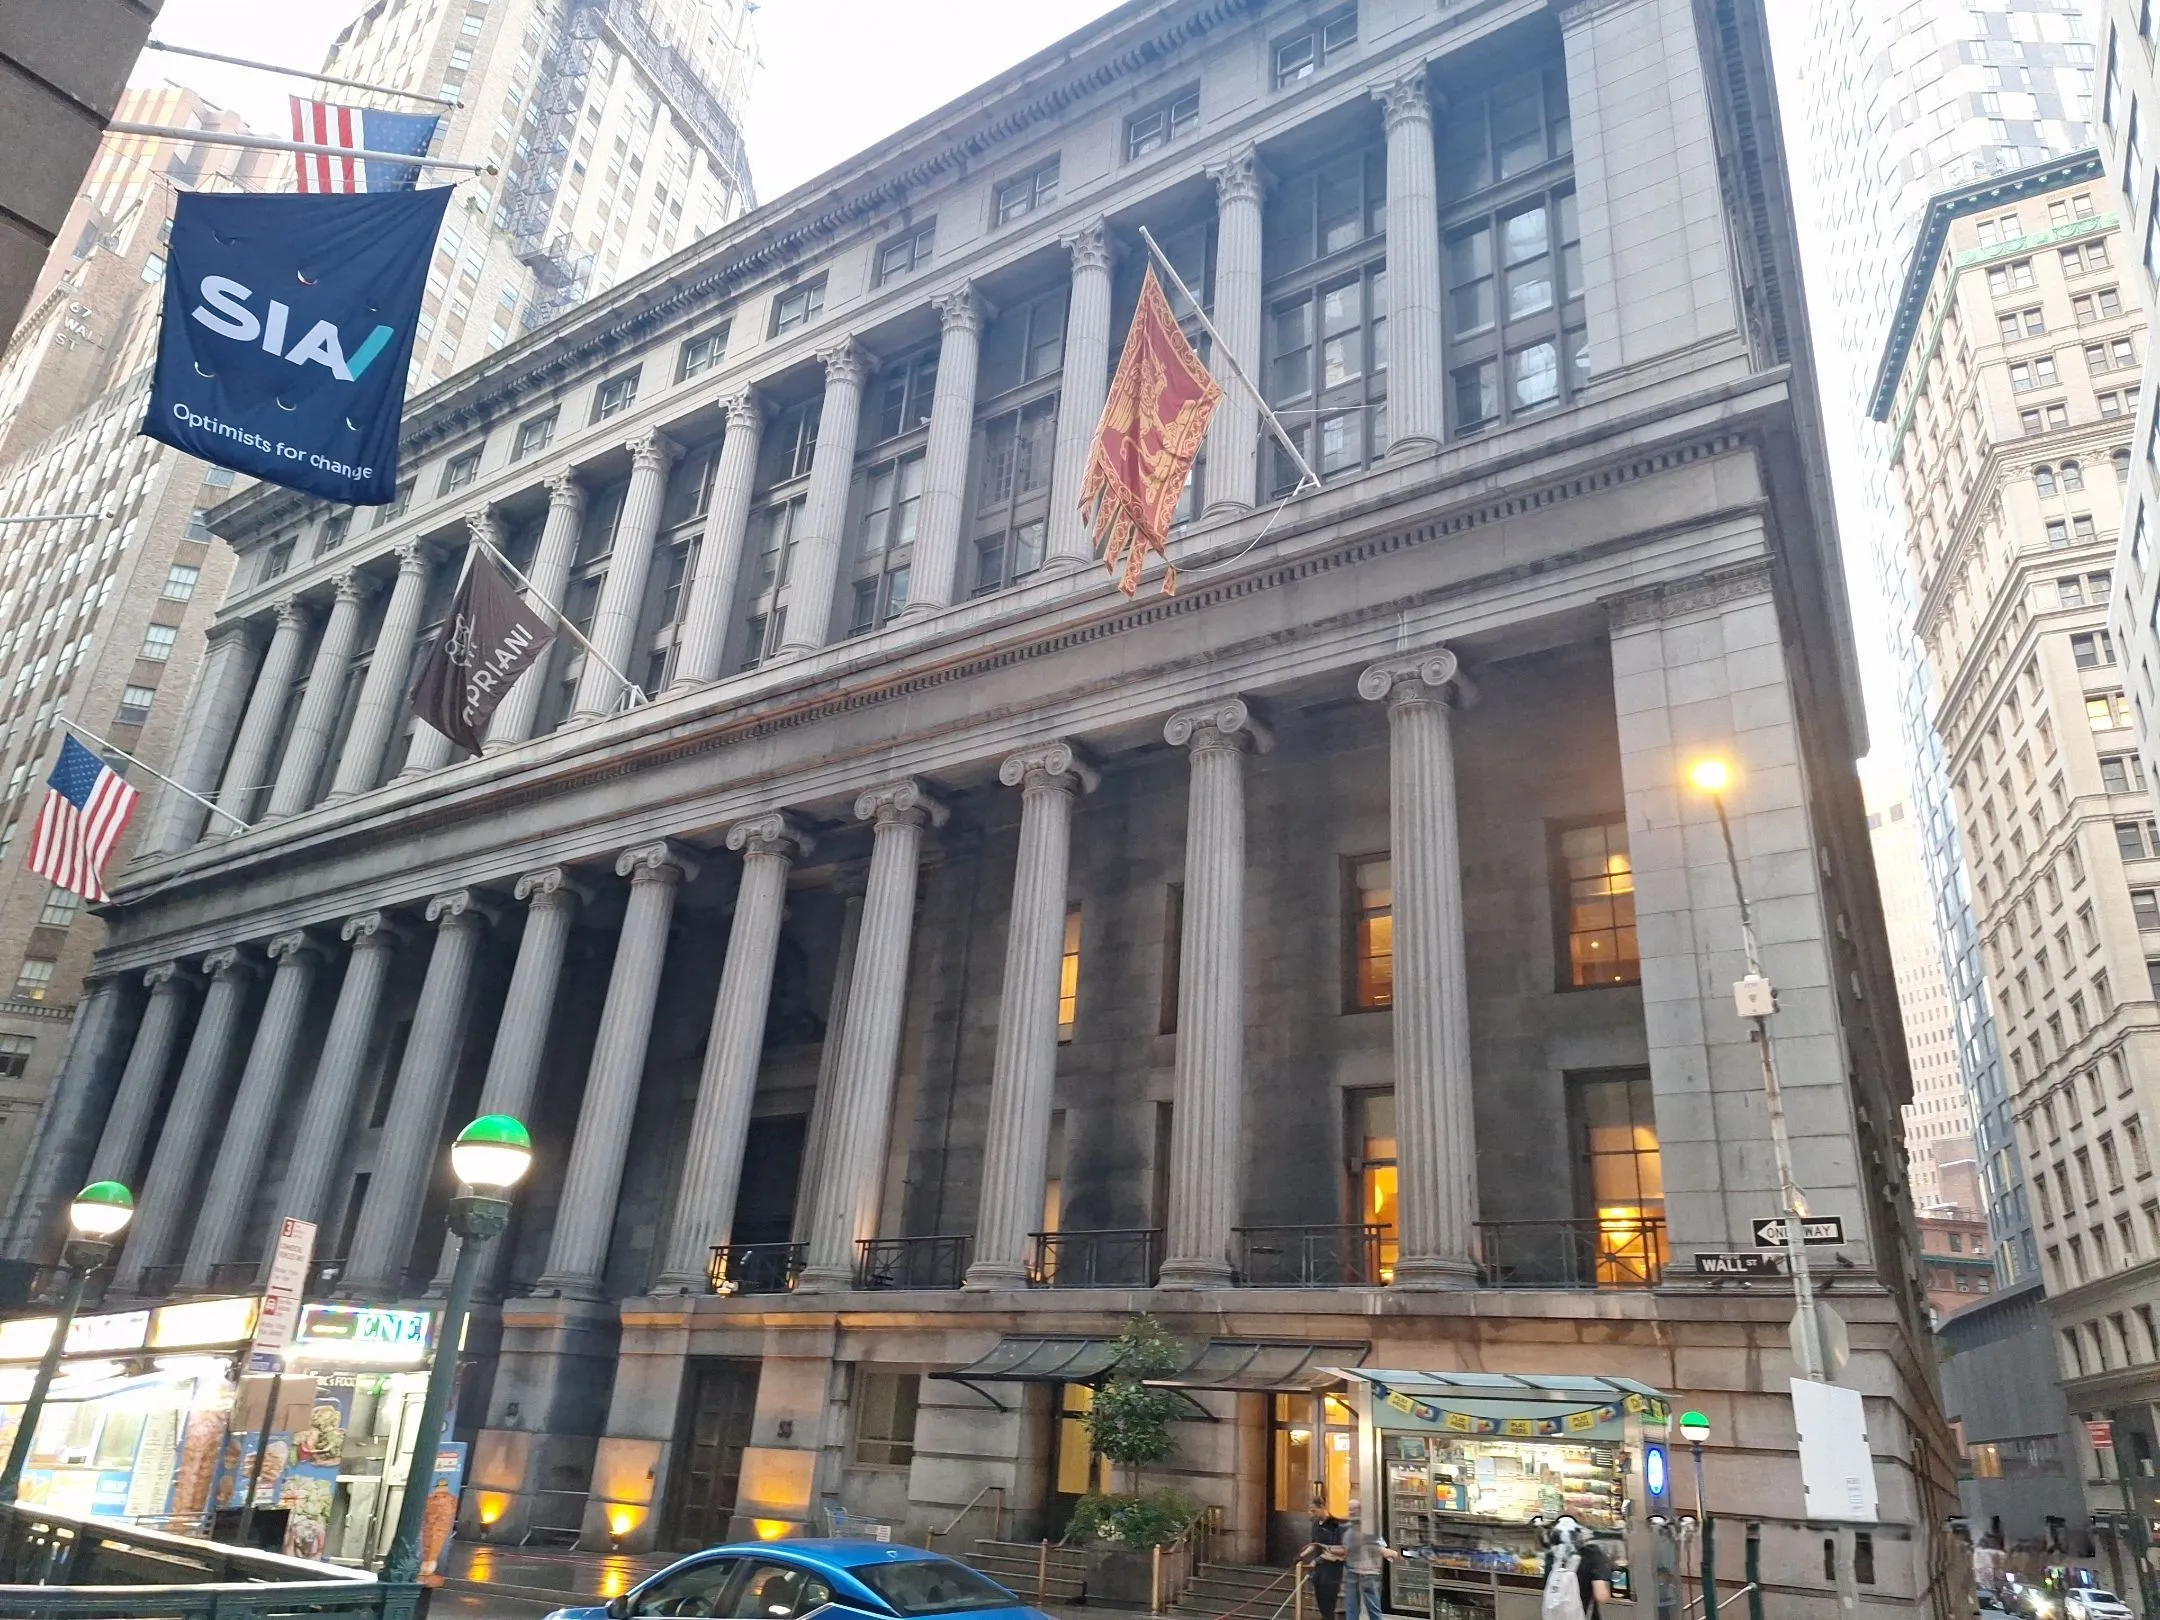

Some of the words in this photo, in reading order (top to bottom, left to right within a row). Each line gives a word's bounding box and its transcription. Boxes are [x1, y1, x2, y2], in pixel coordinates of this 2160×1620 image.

[69, 301, 93, 318] 67
[55, 332, 79, 350] ST
[64, 316, 105, 350] WALL
[173, 403, 272, 453] Optimists
[276, 442, 307, 461] for
[310, 454, 373, 481] change
[1803, 1225, 1831, 1237] WAY
[1702, 1259, 1748, 1271] WALL
[1746, 1259, 1757, 1267] ST
